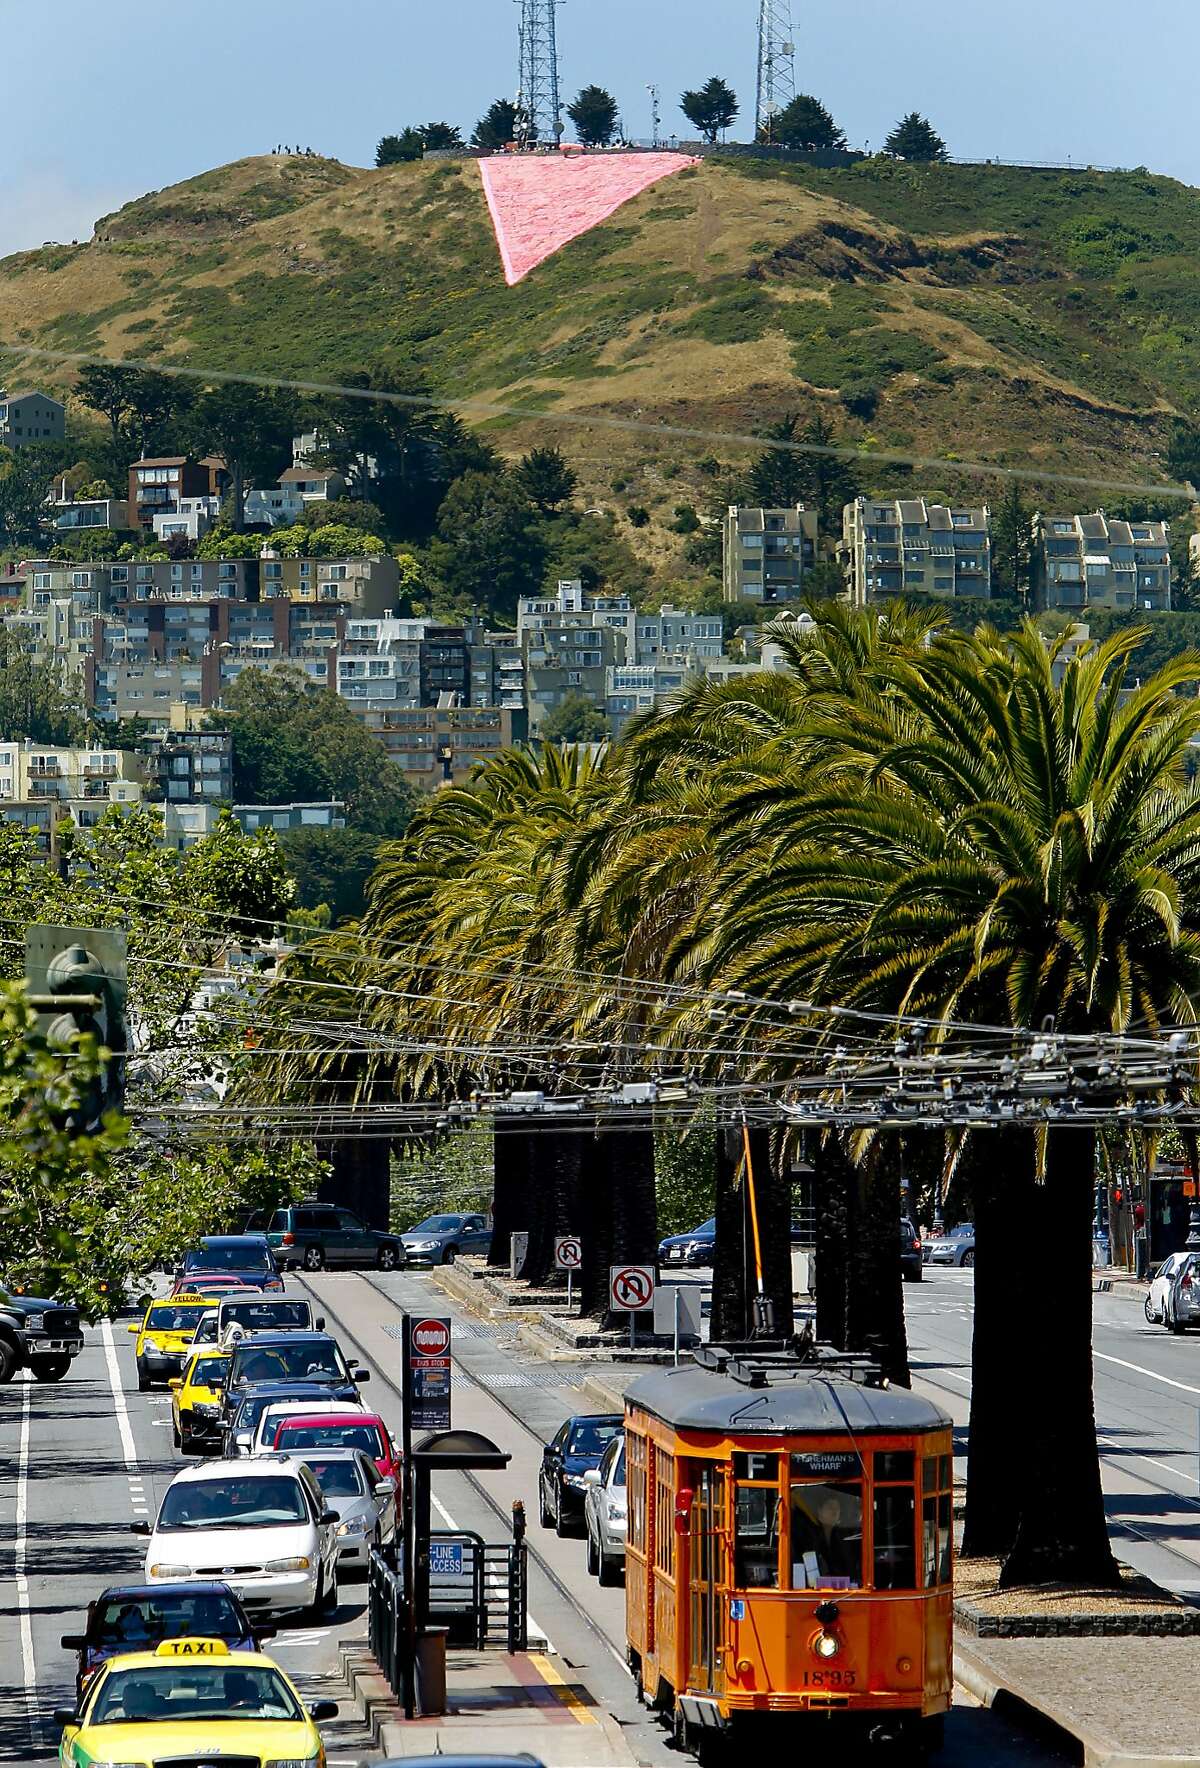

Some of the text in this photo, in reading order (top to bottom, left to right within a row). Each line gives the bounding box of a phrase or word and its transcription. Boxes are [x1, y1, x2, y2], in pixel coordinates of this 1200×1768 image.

[747, 1453, 767, 1479] F
[809, 1462, 842, 1470] WHARF
[171, 1642, 214, 1654] TAXI
